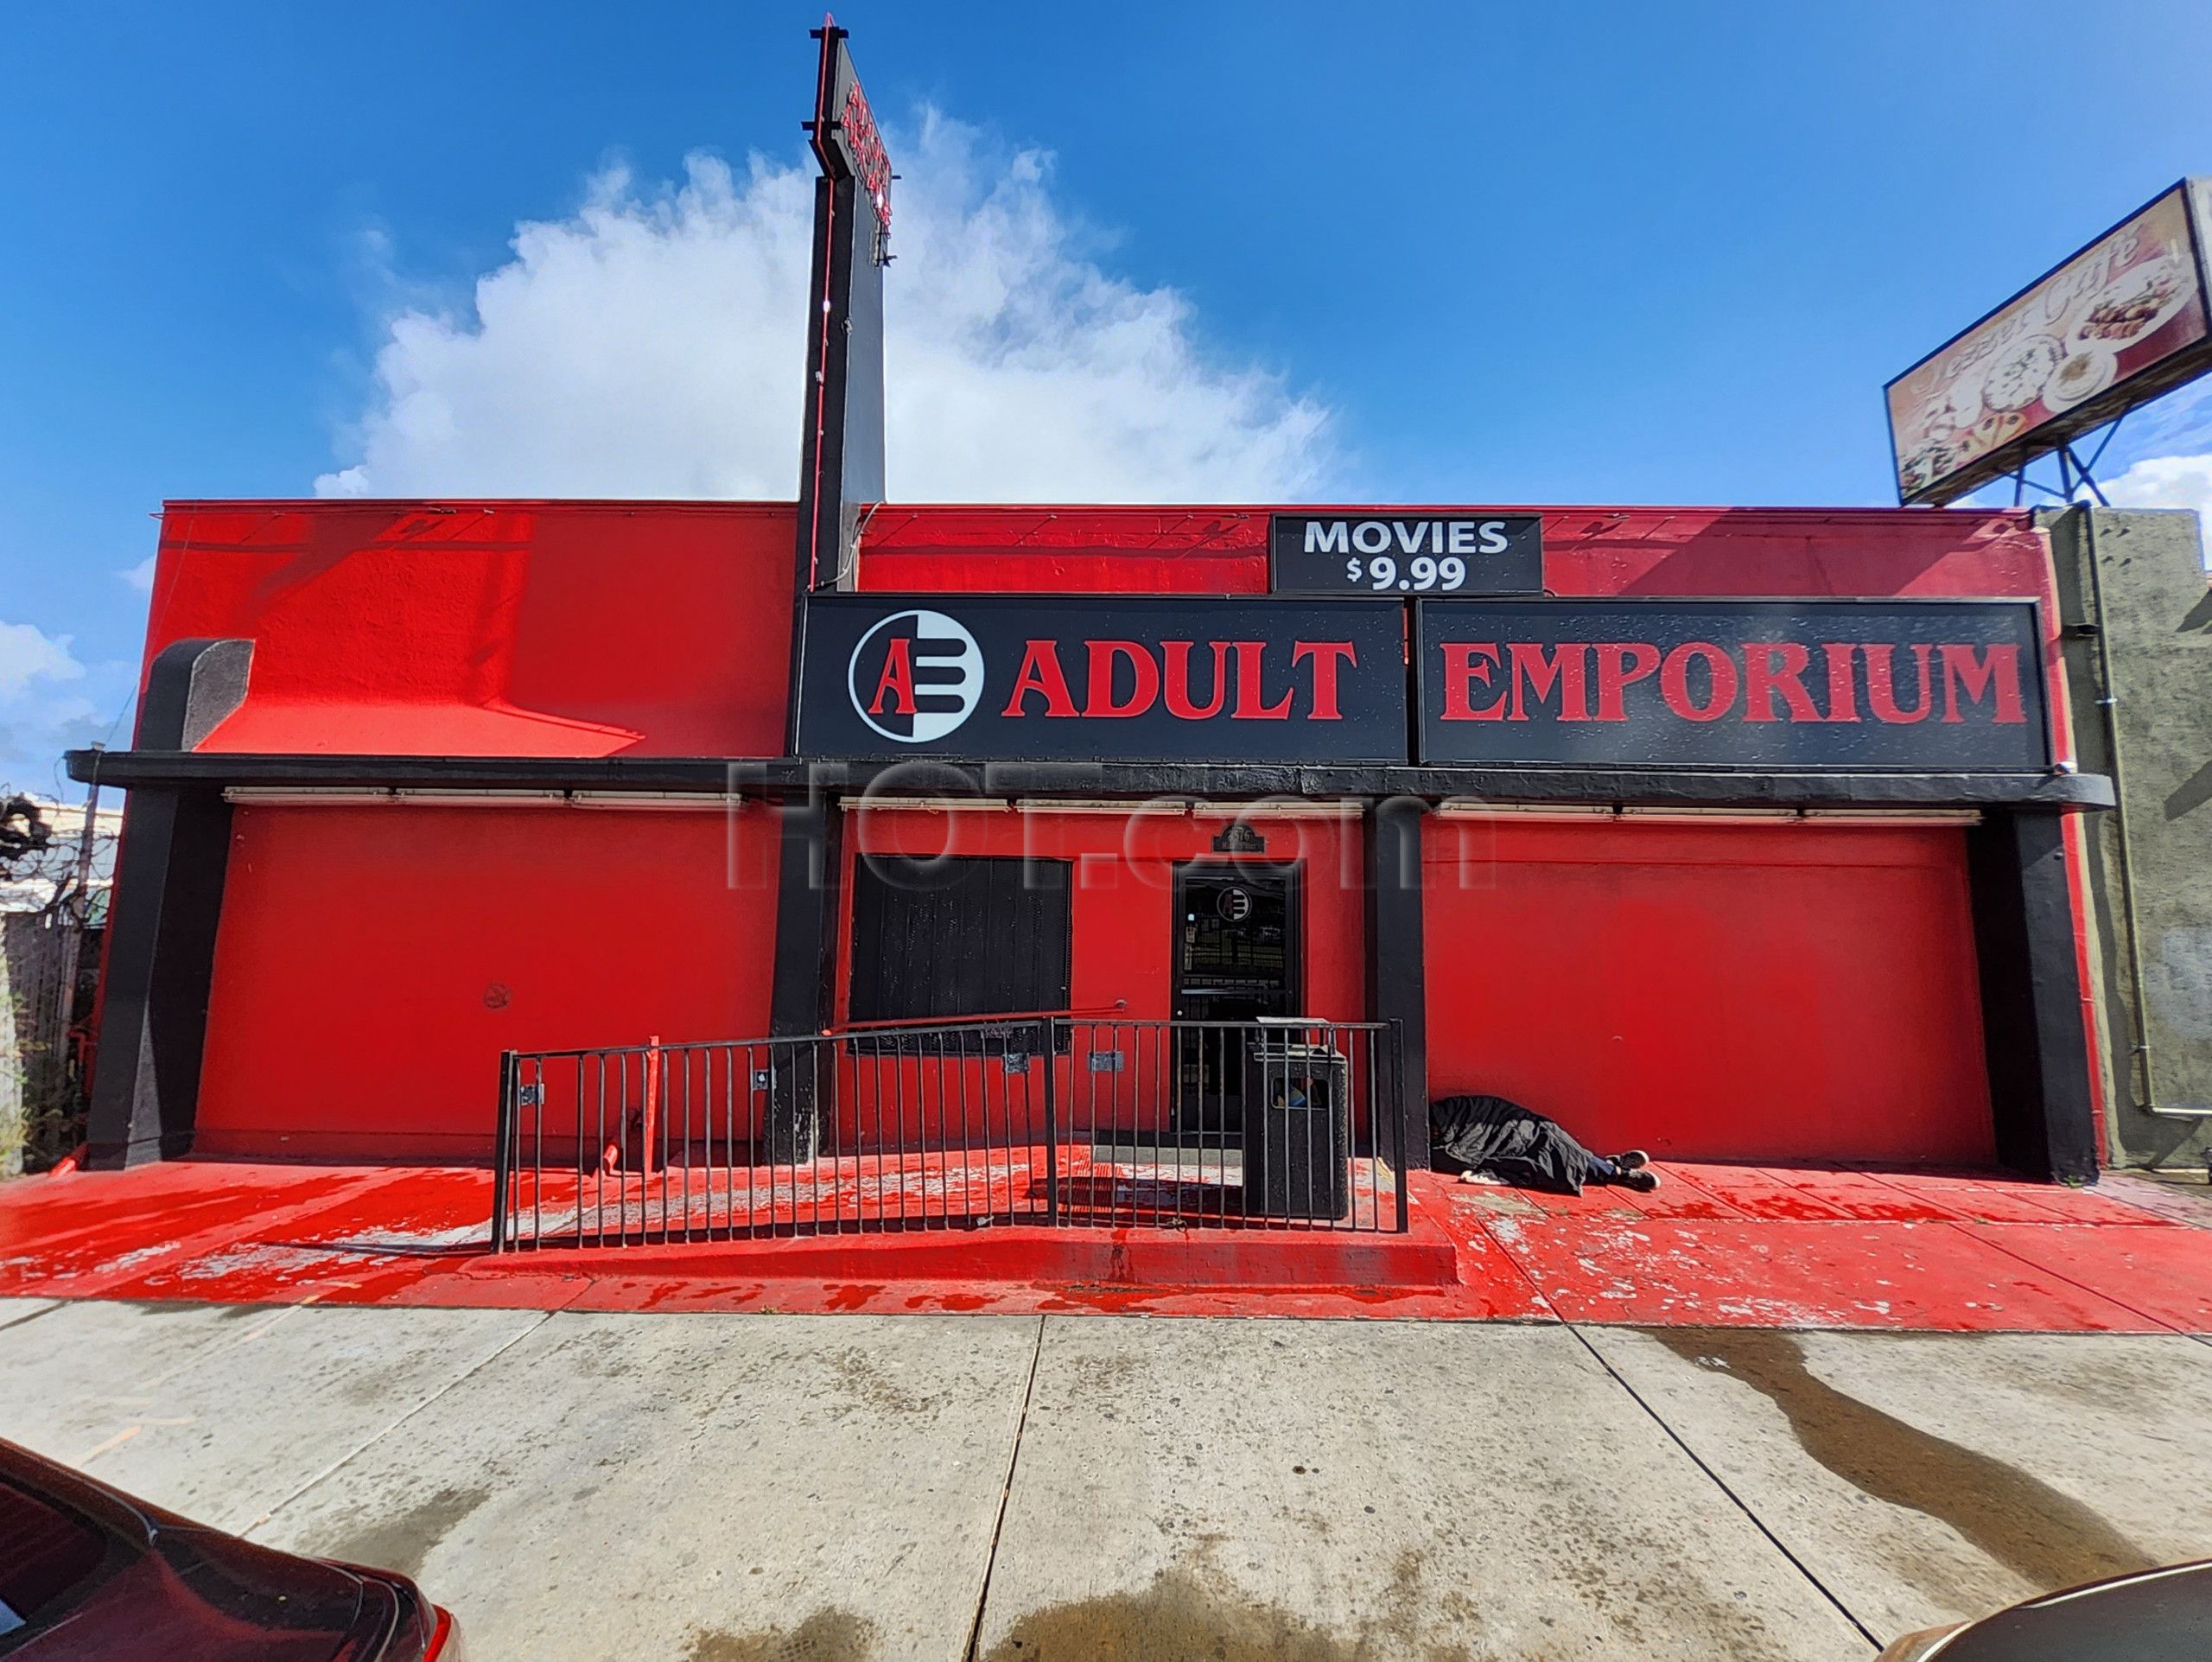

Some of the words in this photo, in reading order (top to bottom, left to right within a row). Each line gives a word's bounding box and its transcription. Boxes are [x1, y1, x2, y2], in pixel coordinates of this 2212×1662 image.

[1304, 521, 1508, 554] MOVIES
[1347, 557, 1465, 590] $9.99
[1001, 639, 1357, 721] ADULT
[1440, 641, 2026, 724] EMPORIUM
